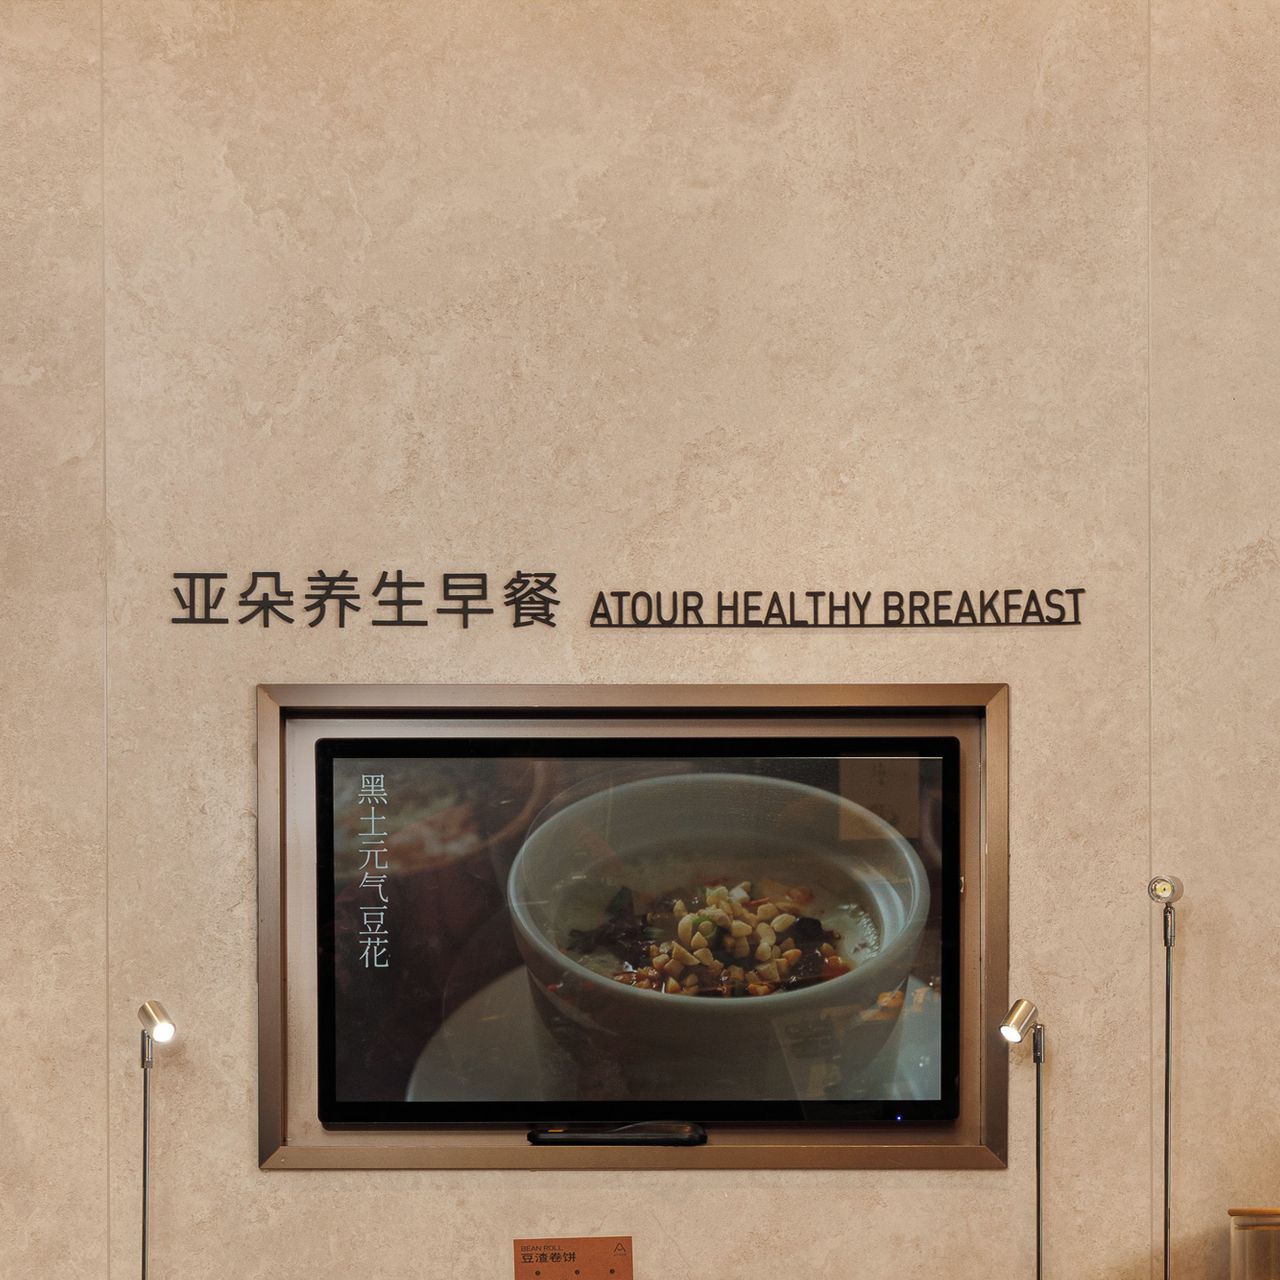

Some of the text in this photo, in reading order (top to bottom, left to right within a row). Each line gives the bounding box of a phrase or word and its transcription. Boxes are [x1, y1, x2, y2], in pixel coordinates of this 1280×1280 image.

[170, 569, 561, 630] 亚朵养生早餐
[589, 587, 1086, 625] ATOUR HEALTHY BREAKFAST
[357, 774, 389, 968] 黑土元气豆花
[521, 1252, 576, 1263] 豆渣卷饼
